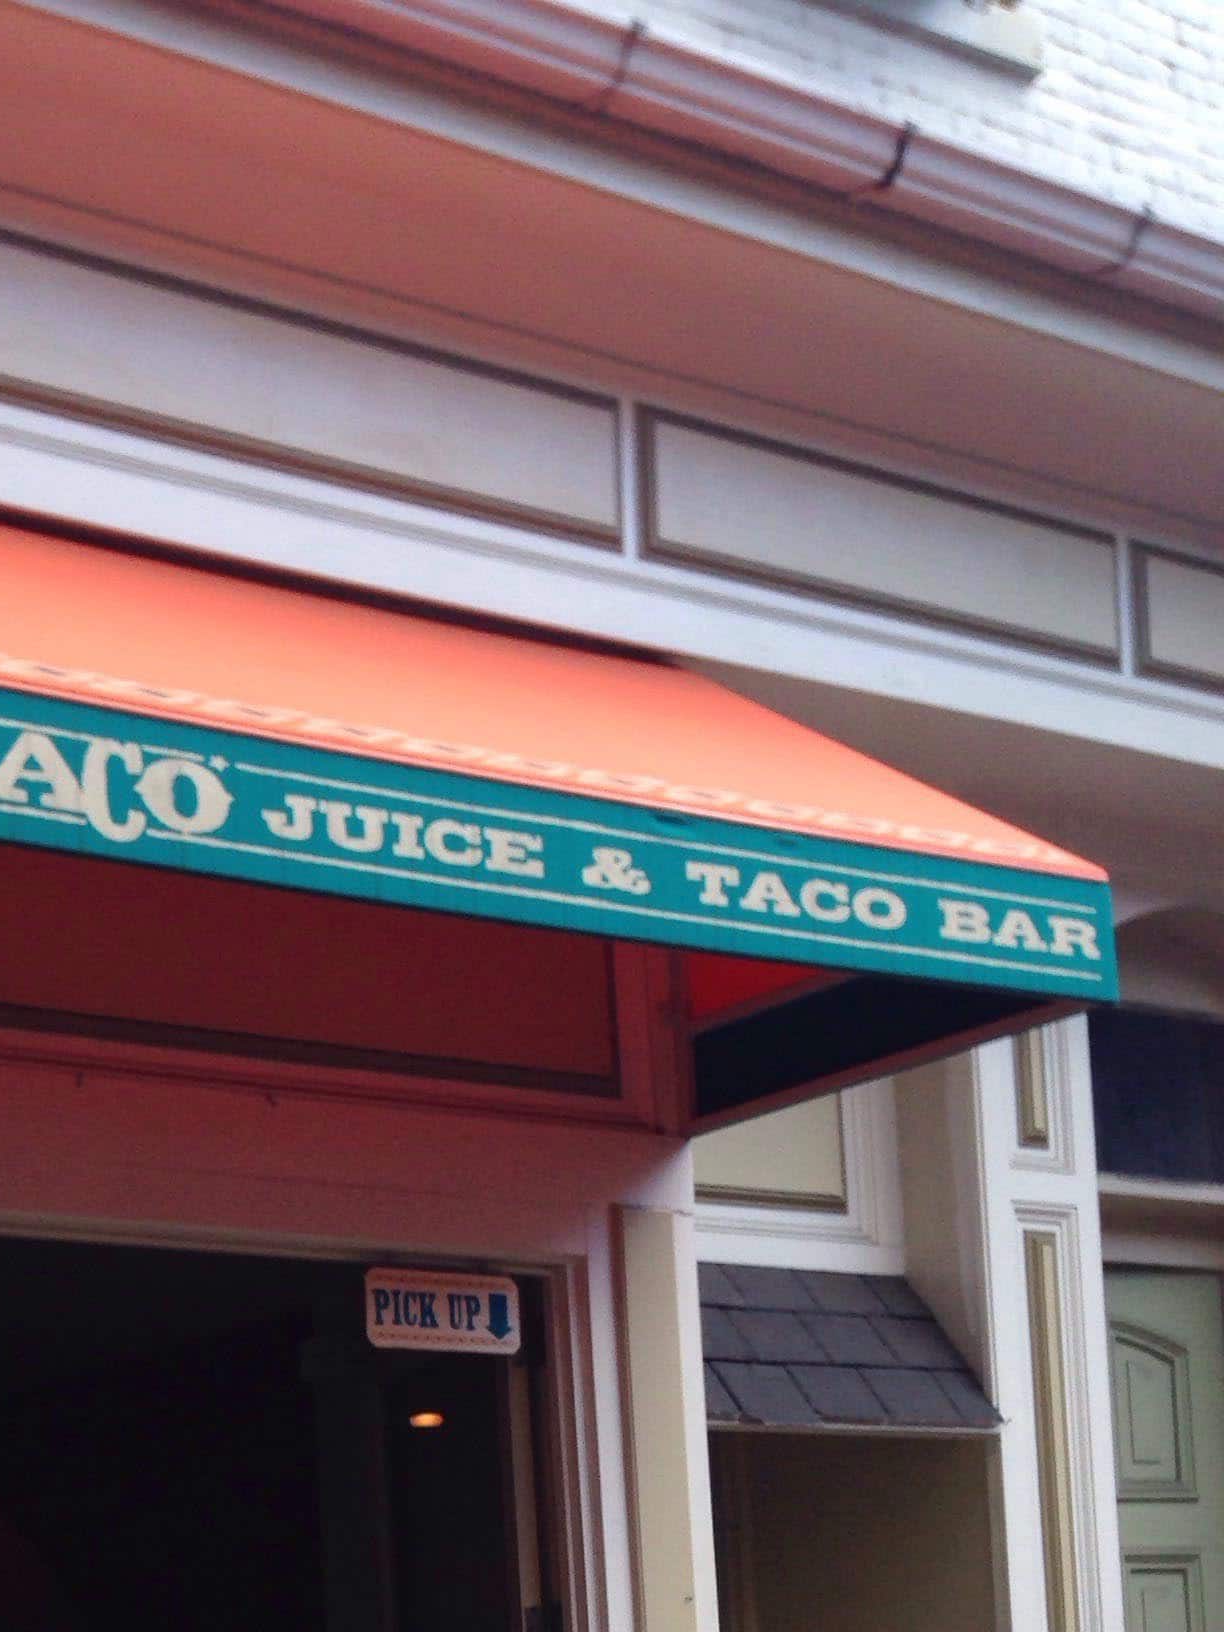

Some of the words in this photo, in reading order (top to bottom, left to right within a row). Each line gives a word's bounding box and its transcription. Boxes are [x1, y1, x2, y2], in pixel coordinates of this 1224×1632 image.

[261, 794, 545, 878] JUICE
[582, 846, 651, 896] &
[686, 860, 907, 931] TACO
[939, 898, 1101, 961] BAR
[372, 1288, 440, 1329] PICK
[447, 1293, 481, 1331] UP
